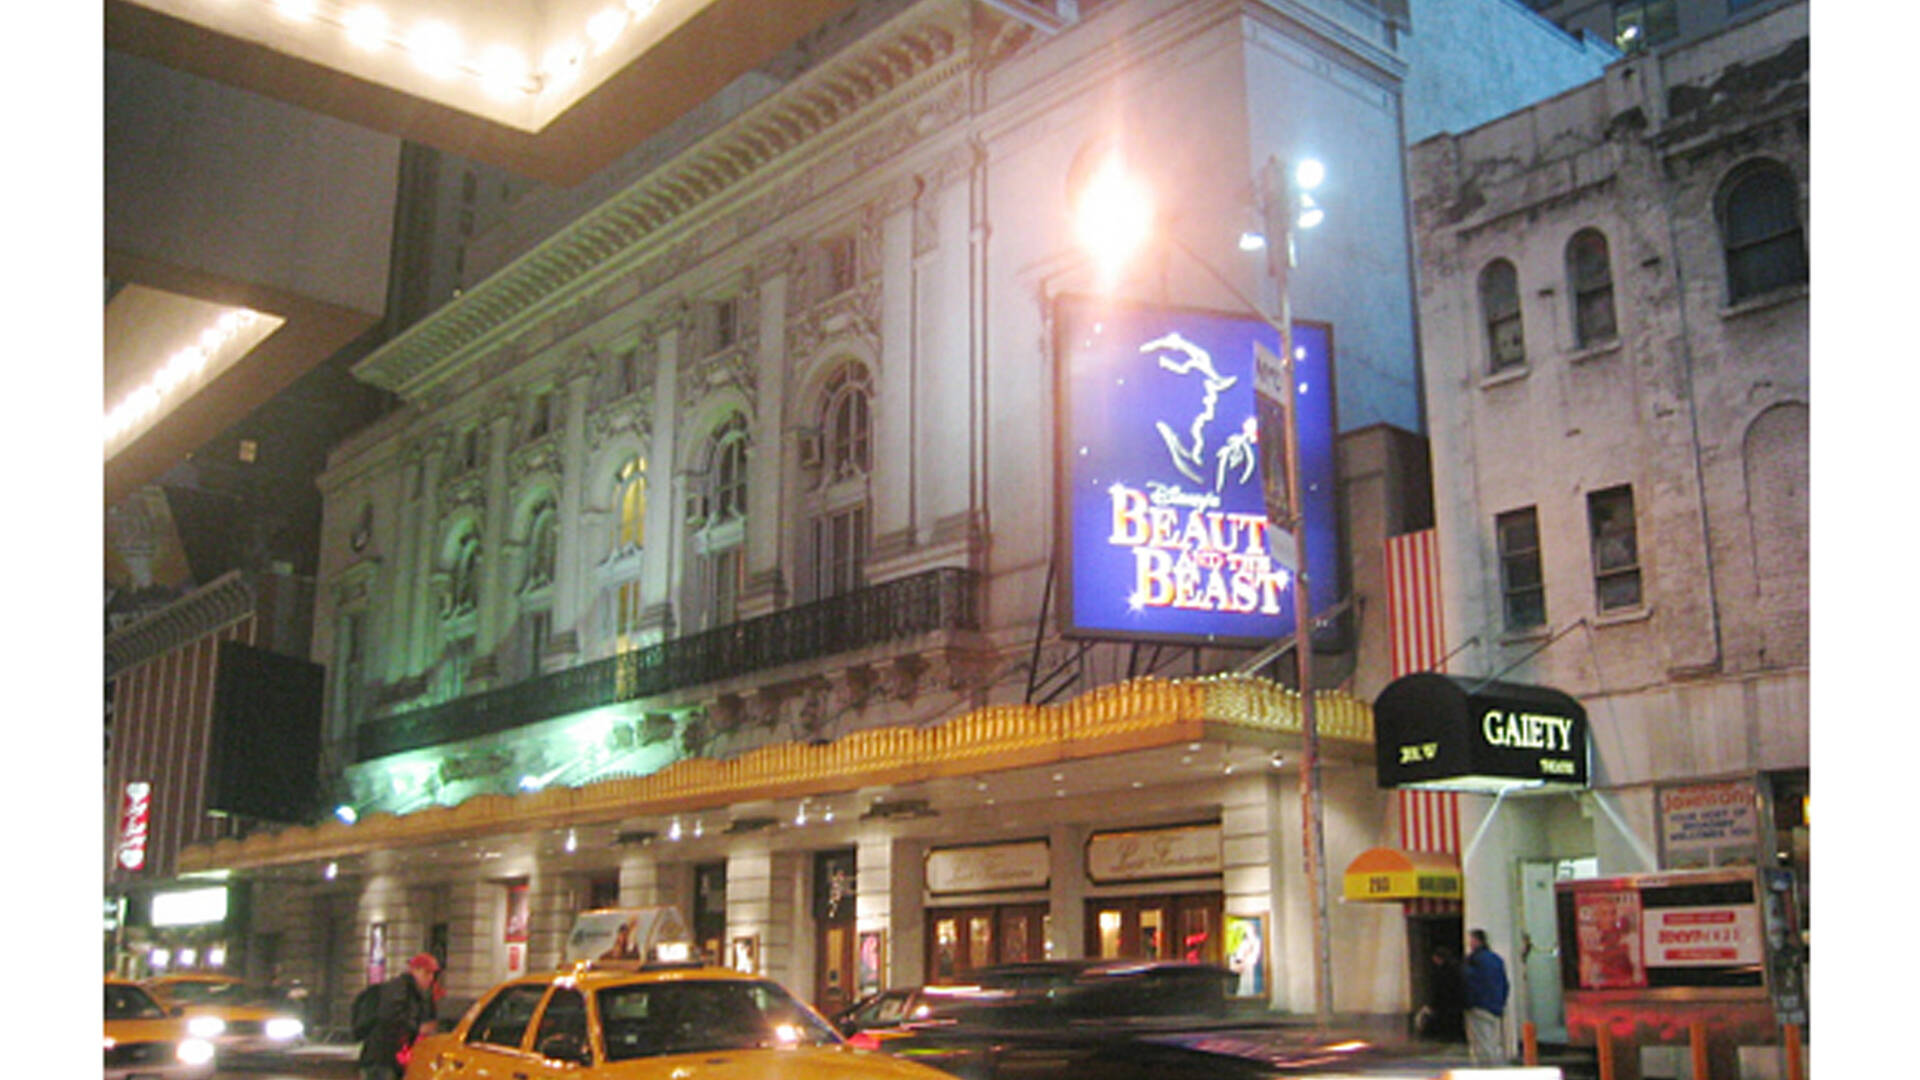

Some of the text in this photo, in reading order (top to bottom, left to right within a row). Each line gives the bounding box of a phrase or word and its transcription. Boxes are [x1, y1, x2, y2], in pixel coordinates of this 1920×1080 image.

[1108, 483, 1270, 555] BEAUT
[1131, 547, 1288, 615] BEAST
[1482, 709, 1573, 751] GAIETY
